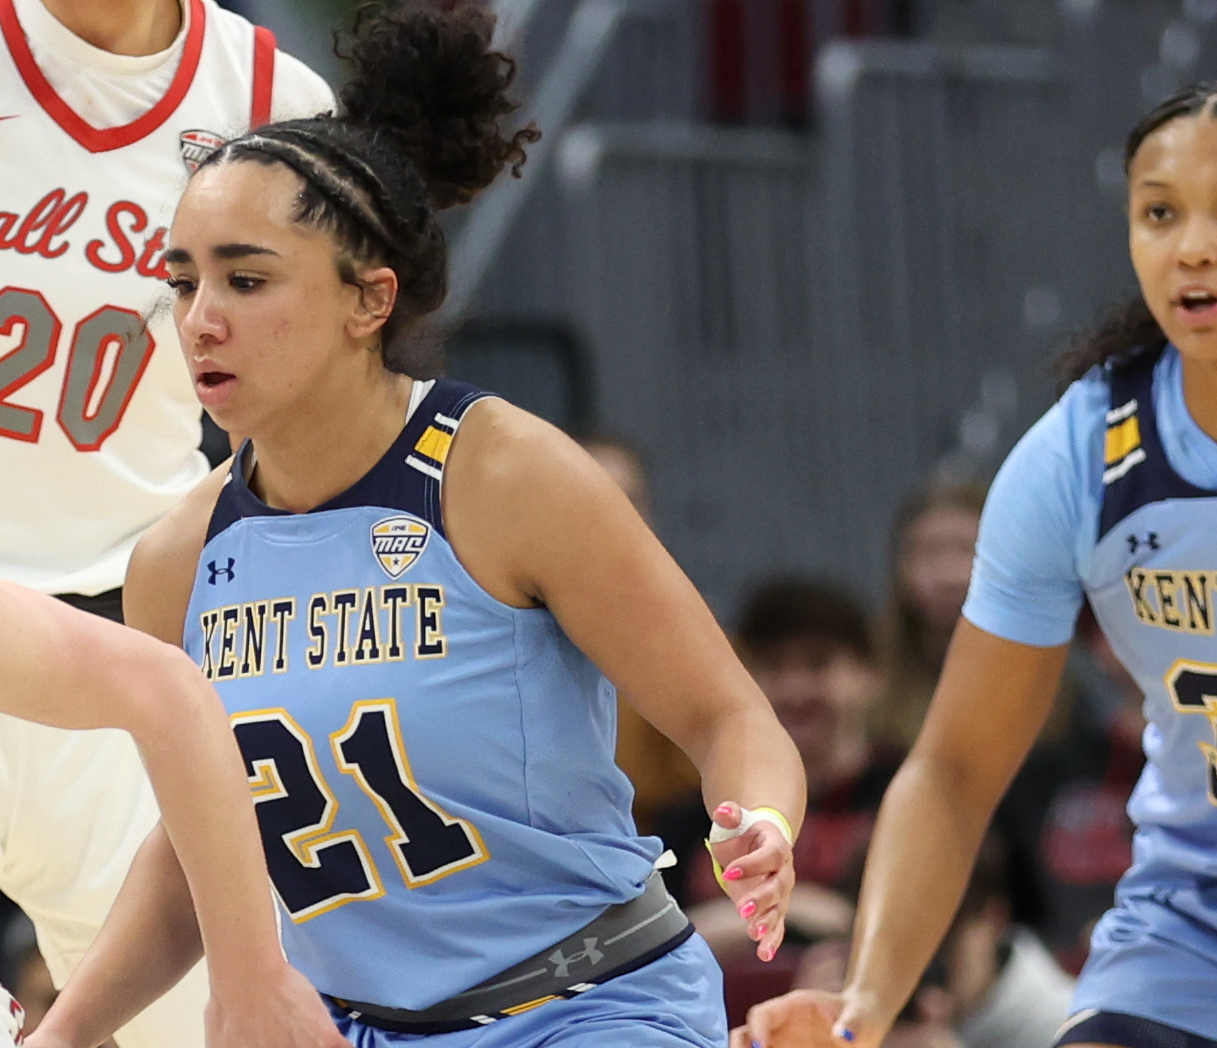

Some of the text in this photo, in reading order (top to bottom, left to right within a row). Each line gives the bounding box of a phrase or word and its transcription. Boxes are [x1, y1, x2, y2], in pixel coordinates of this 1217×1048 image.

[373, 536, 424, 553] MAC
[199, 583, 449, 682] KENT STATE
[1123, 567, 1217, 637] KEN
[229, 697, 491, 925] 21
